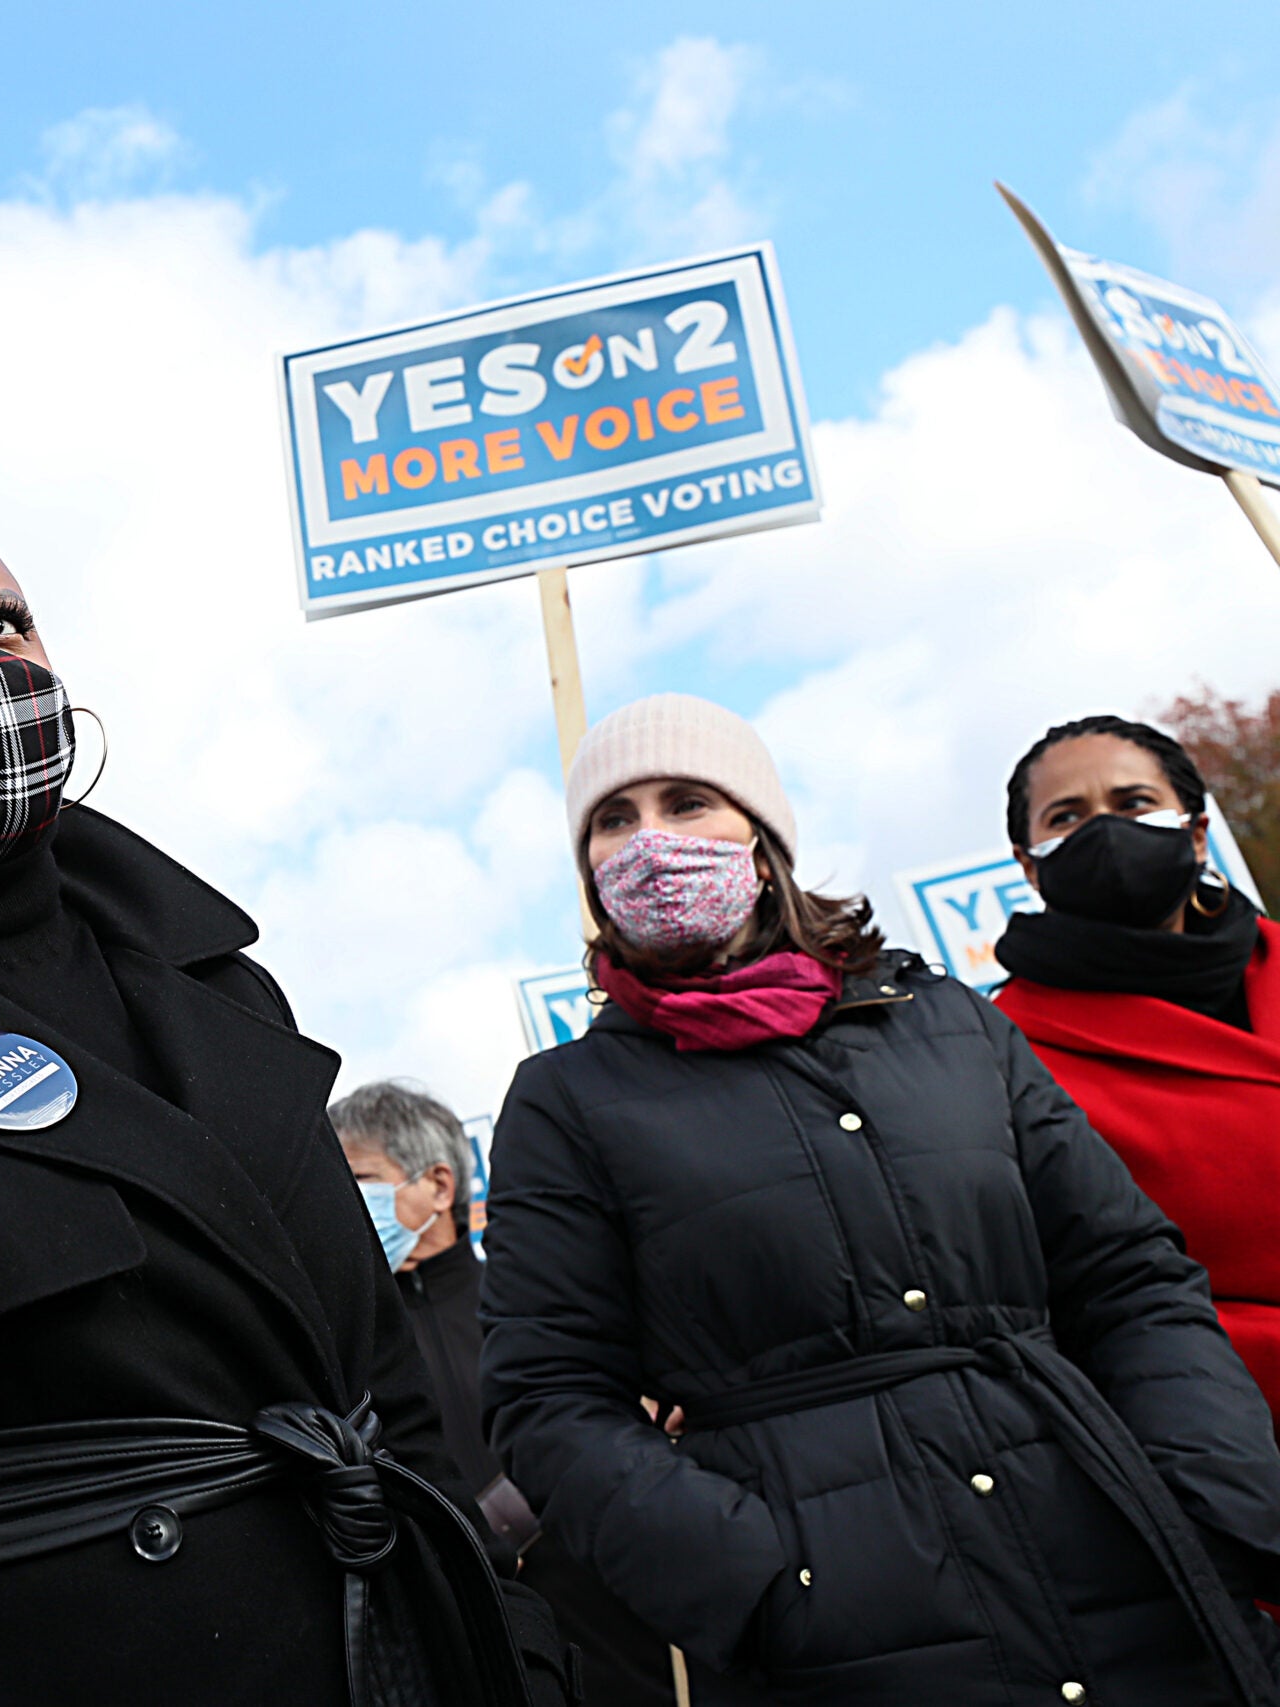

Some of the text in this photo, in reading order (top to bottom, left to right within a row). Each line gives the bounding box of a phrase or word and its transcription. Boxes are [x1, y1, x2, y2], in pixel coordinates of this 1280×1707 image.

[322, 299, 738, 444] YES ON 2
[1197, 320, 1255, 376] 2
[340, 376, 746, 501] MORE VOICE
[311, 530, 475, 582] RANKED
[481, 497, 636, 552] CHOICE
[641, 459, 804, 518] VOTING
[942, 879, 1041, 931] YE
